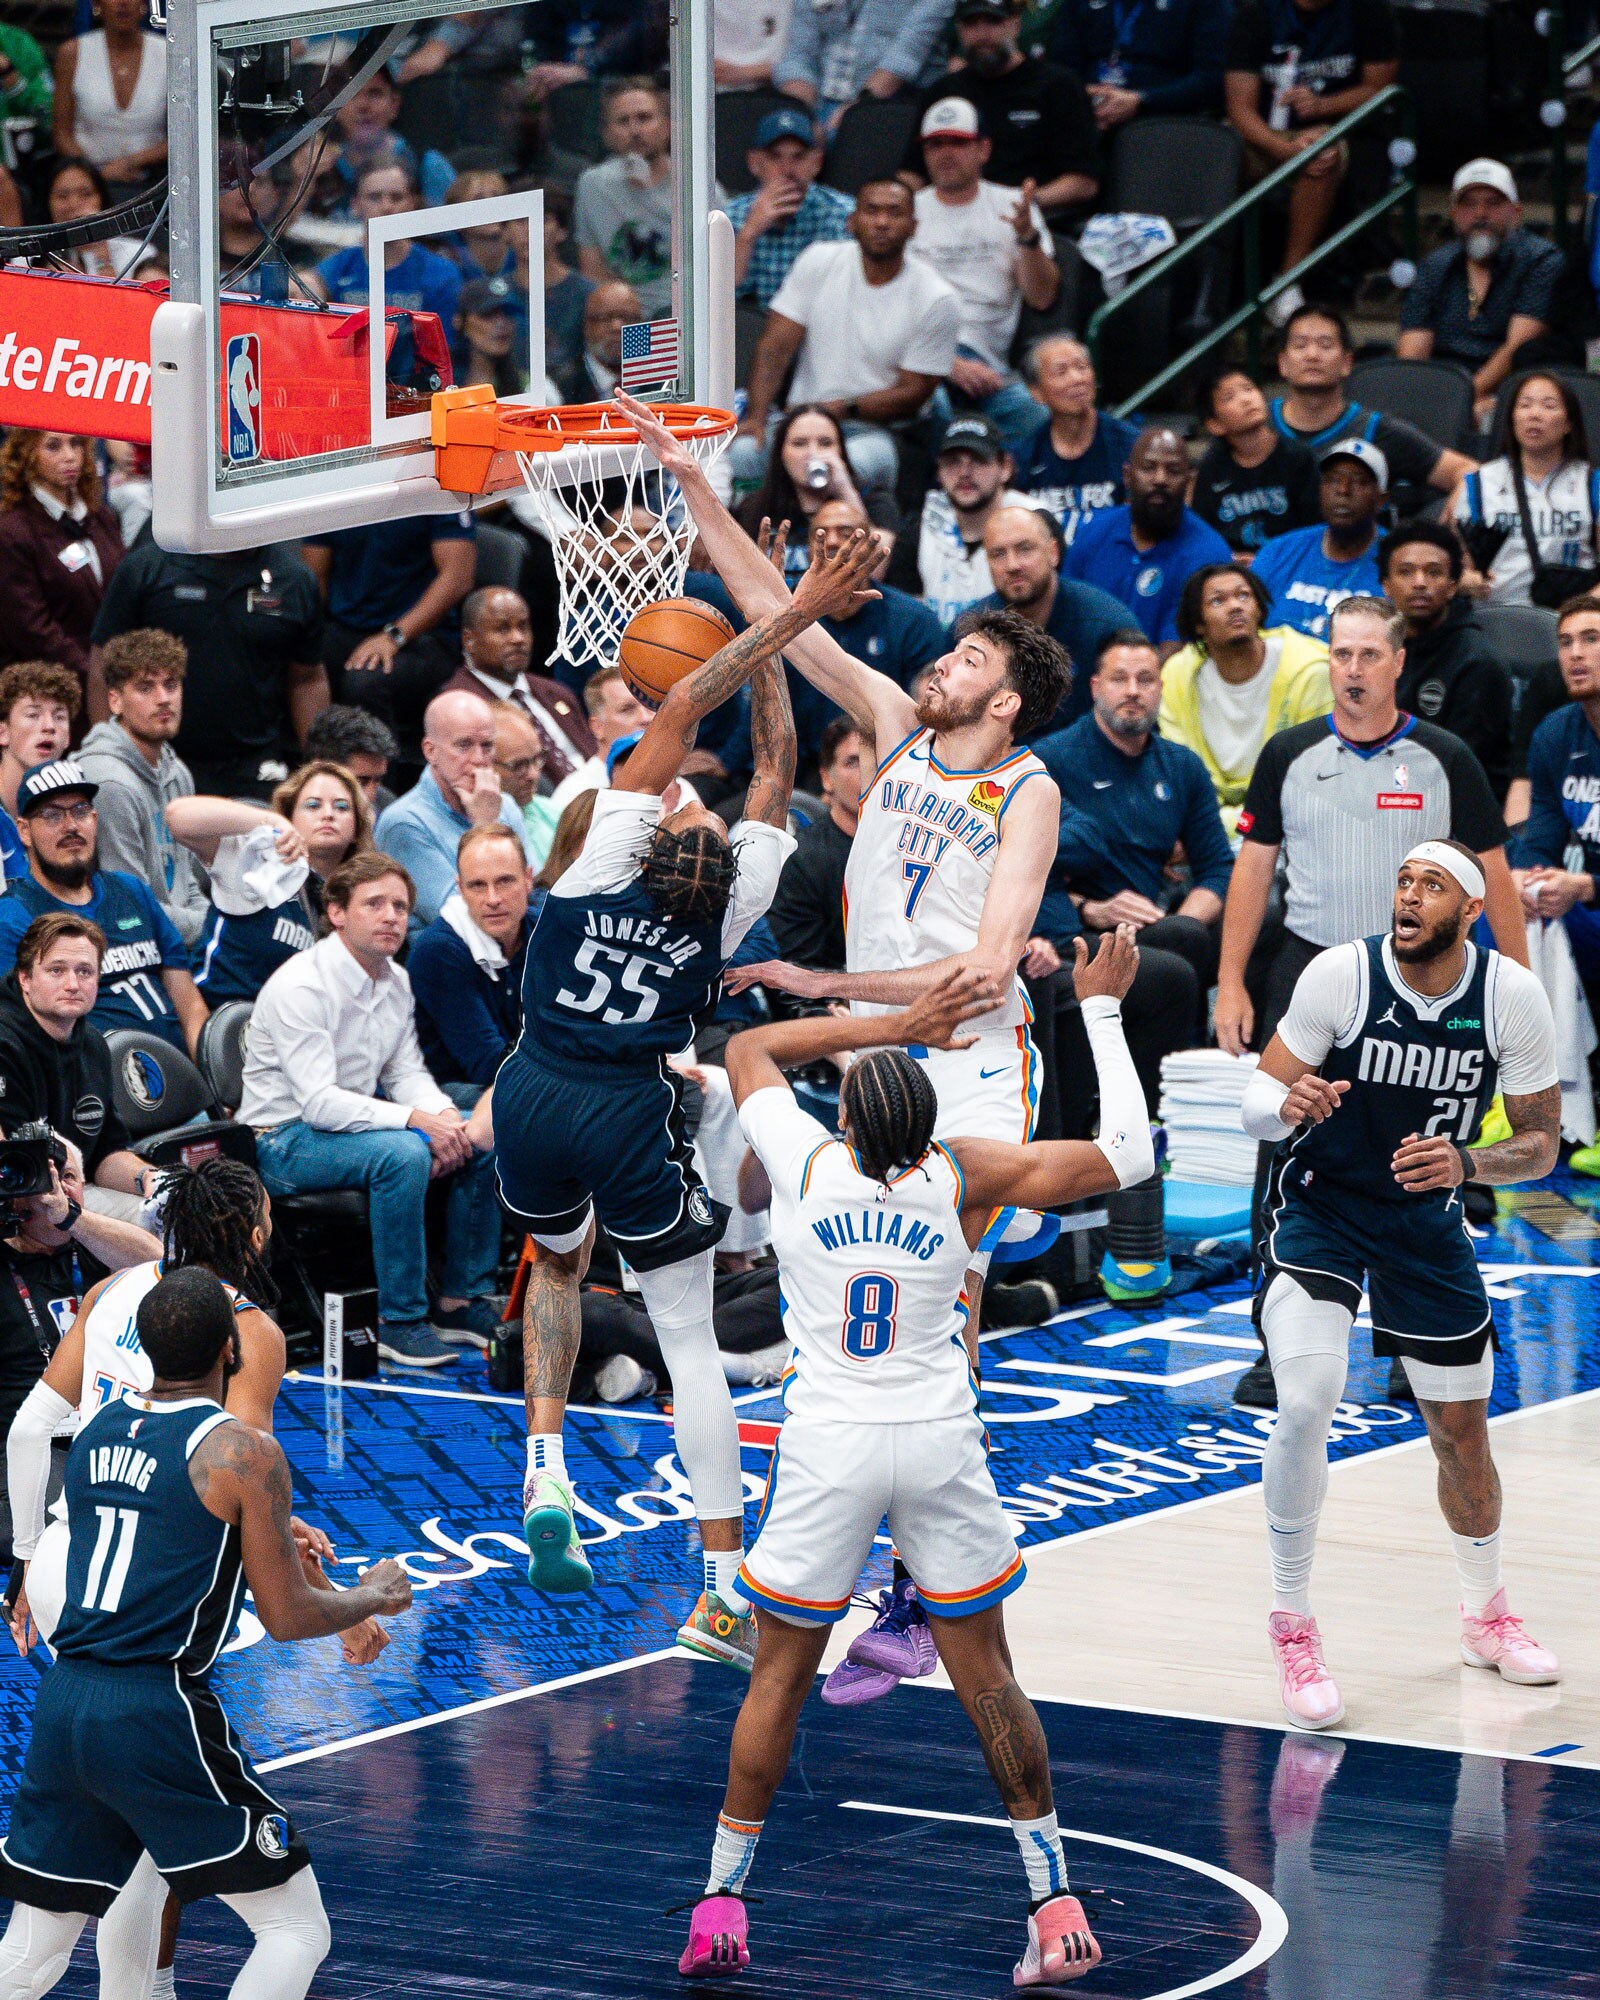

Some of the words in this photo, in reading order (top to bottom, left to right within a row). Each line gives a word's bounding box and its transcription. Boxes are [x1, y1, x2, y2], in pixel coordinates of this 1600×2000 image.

[233, 432, 250, 454] NBA
[881, 779, 998, 861] OKLAHOMA
[897, 820, 954, 867] CITY
[902, 858, 934, 922] 7
[584, 910, 667, 947] JONES
[661, 934, 702, 971] JR.
[110, 972, 167, 1021] 77
[555, 937, 675, 1025] 55
[1446, 1017, 1481, 1030] chime
[1424, 1097, 1478, 1141] 21
[811, 1210, 944, 1261] WILLIAMS
[330, 1319, 338, 1359] POPCORN
[841, 1270, 900, 1363] 8
[89, 1445, 158, 1493] IRVING
[403, 1506, 526, 1521] SHAWN
[81, 1505, 140, 1613] 11
[457, 1623, 561, 1639] TERRY
[569, 1618, 671, 1634] DAVIS
[463, 1606, 594, 1624] POWELL
[519, 1635, 600, 1647] RODNEY
